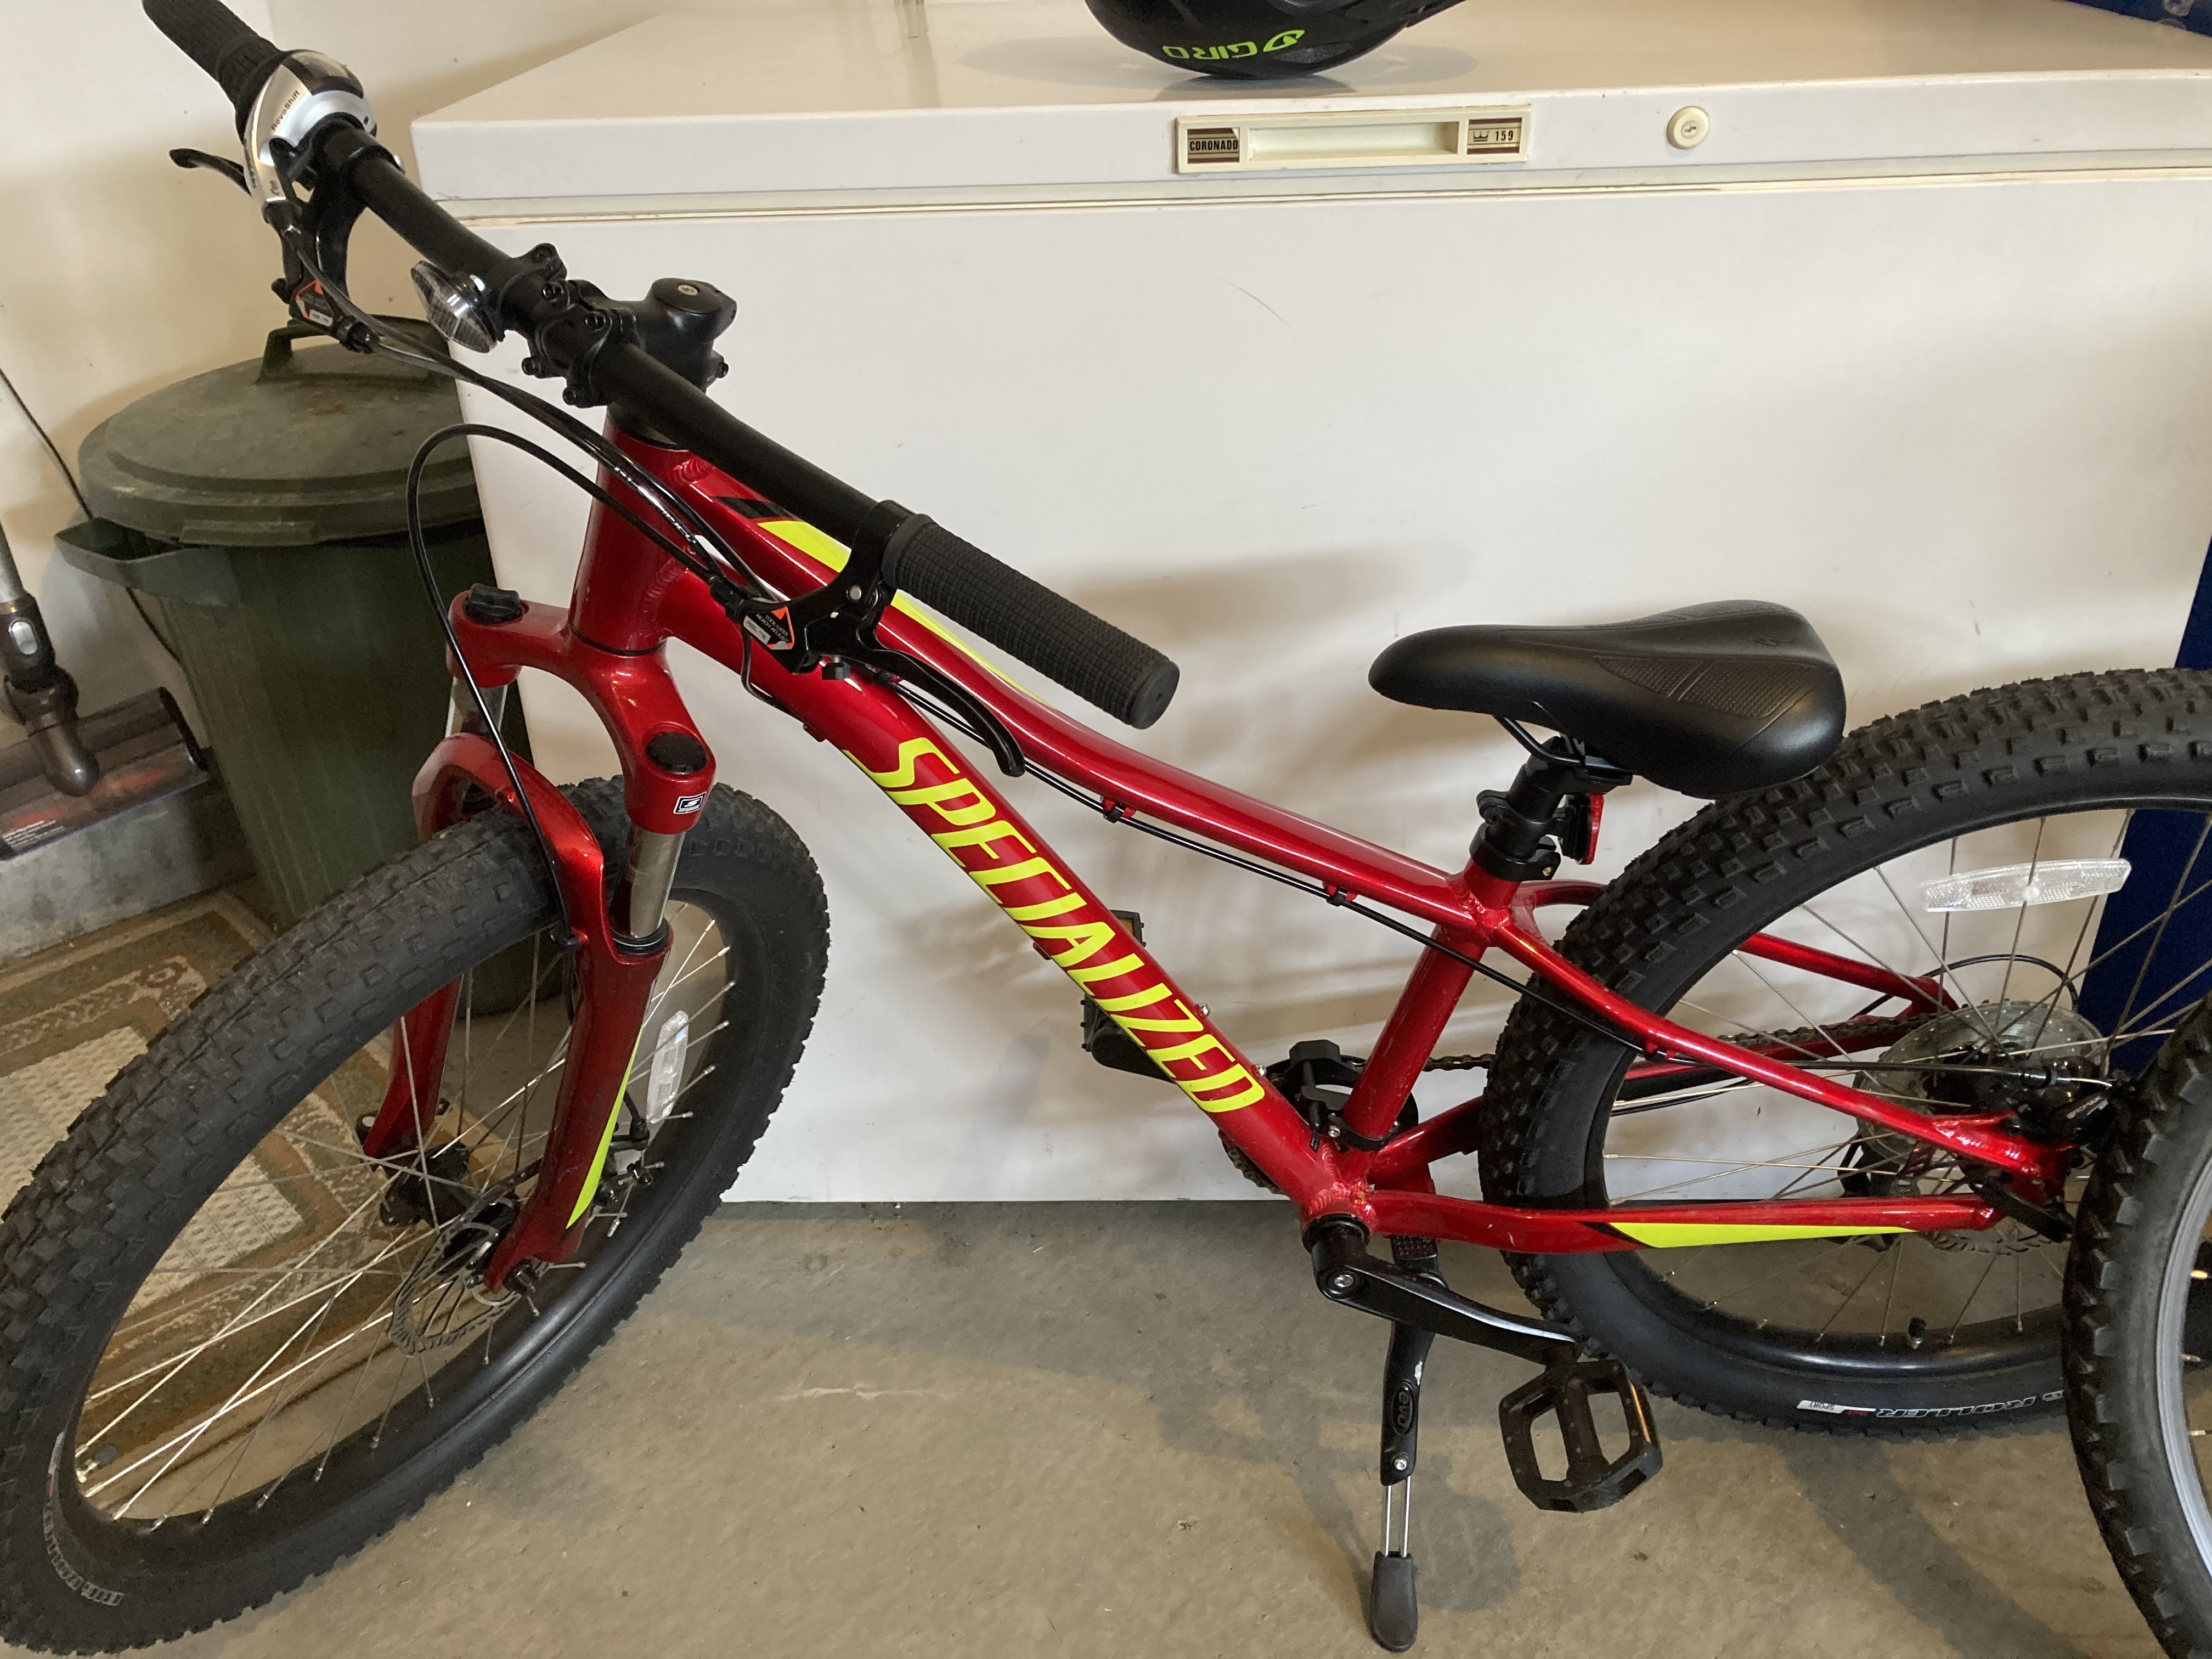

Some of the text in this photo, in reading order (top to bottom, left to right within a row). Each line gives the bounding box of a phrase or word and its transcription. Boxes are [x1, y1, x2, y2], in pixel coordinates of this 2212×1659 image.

[1162, 41, 1258, 59] GIRO
[271, 90, 300, 131] RevoShift
[1189, 139, 1238, 151] CORONADO
[1496, 131, 1514, 141] 159
[842, 737, 1265, 1113] SPECIALIZED
[1398, 1391, 1409, 1426] evo
[1809, 1401, 1835, 1410] SPORT
[1876, 1396, 2036, 1418] ROLLER
